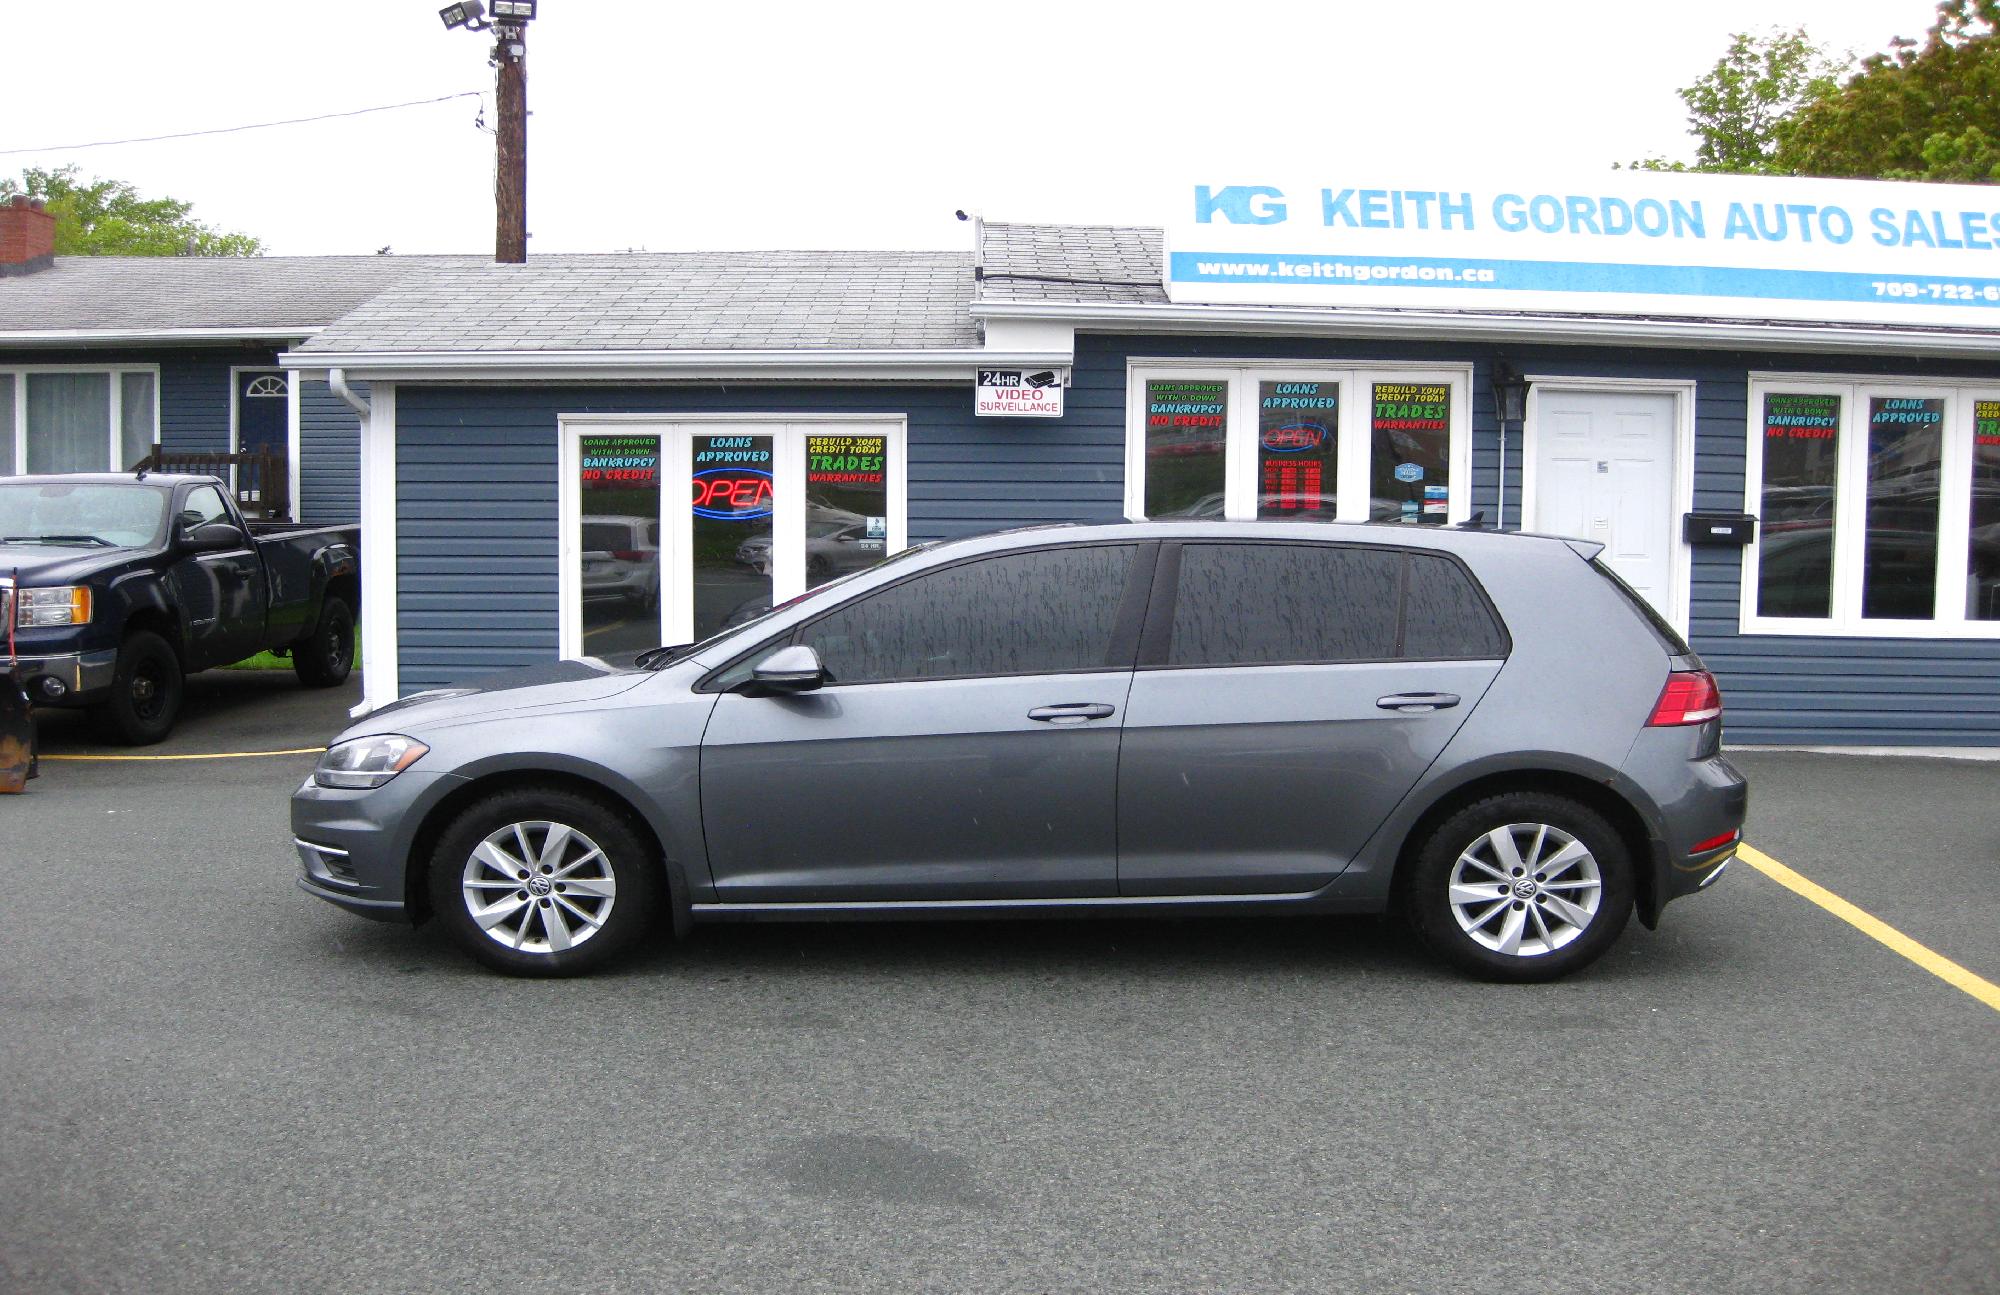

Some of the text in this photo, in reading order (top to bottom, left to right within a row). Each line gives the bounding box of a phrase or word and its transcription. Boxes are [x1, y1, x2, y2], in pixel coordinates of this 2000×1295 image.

[1195, 185, 1287, 225] KG
[1321, 188, 1475, 231] KEITH
[1492, 193, 1706, 239] GORDON
[1724, 202, 1854, 245] AUTO
[1196, 261, 1495, 282] www.keithgordon.ca
[1871, 281, 2000, 301] 709-722-6
[982, 371, 1019, 386] 24HR
[1179, 384, 1224, 392] APPROVED
[1275, 383, 1319, 394] LOANS
[1375, 385, 1446, 395] REBUILD YOUR
[995, 389, 1044, 401] VIDEO
[1190, 394, 1216, 402] DOWN
[1375, 393, 1446, 402] CREDIT TODAY
[980, 401, 1058, 412] SURVEILLANCE
[1150, 403, 1224, 414] BANKRUPCY
[1262, 397, 1335, 409] APPROVED
[1884, 399, 1925, 409] LOANS
[1375, 402, 1447, 419] TRADES
[1150, 415, 1222, 426] NO CREDIT
[1767, 415, 1836, 426] BANKRUPCY
[1872, 412, 1940, 424] APPROVED
[1374, 420, 1446, 429] WARRANTIES
[1263, 429, 1323, 447] OPEN
[1766, 427, 1836, 438] NO CREDIT
[583, 438, 656, 446] LOANS APPROVED
[710, 436, 753, 448] LOANS
[809, 437, 882, 446] REBUILD YOUR
[809, 445, 882, 454] CREDIT TODAY
[696, 450, 770, 462] APPROVED
[583, 457, 656, 468] BANKRUPCY
[810, 455, 884, 471] TRADES
[582, 469, 655, 480] NO CREDIT
[809, 473, 882, 482] WARRANTIES
